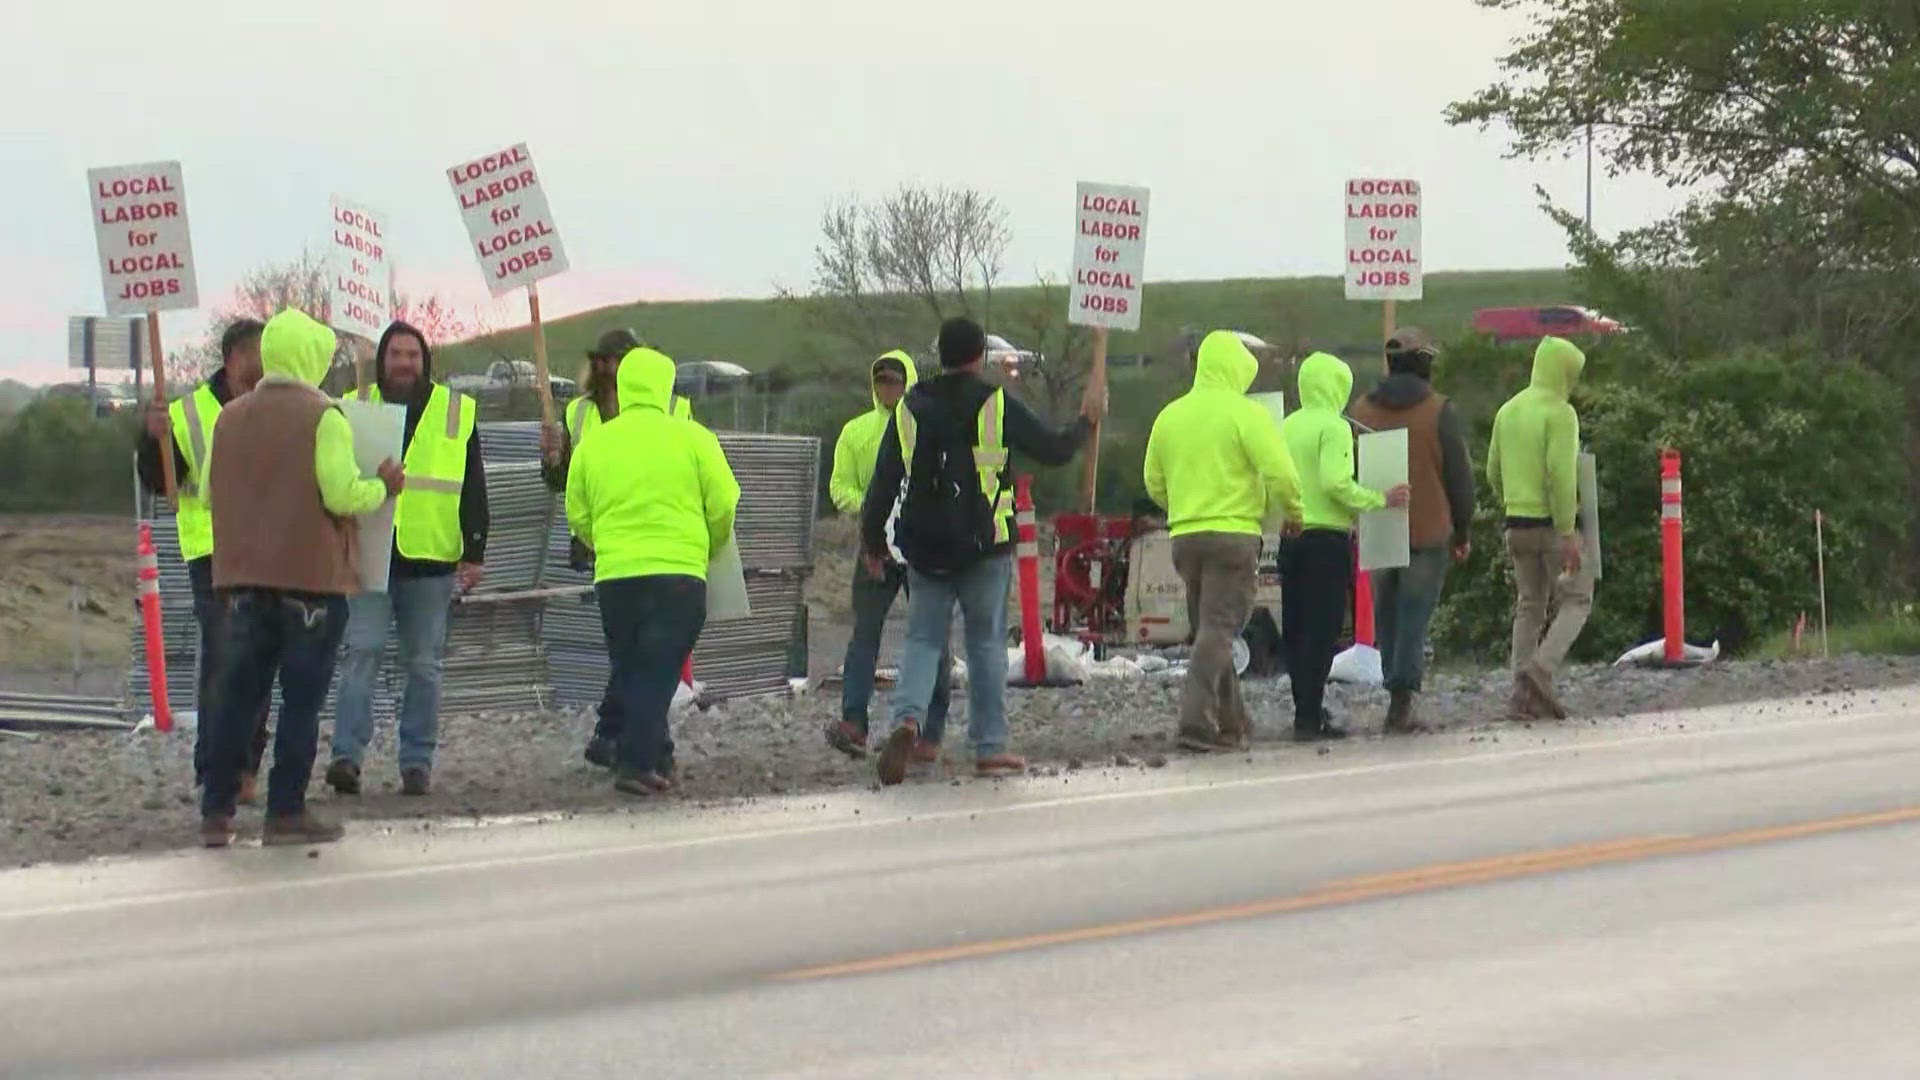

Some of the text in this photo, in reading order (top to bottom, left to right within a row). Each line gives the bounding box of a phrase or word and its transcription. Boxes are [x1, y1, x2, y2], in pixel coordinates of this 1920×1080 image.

[453, 147, 527, 185] LOCAL
[99, 176, 175, 198] LOCAL
[460, 169, 536, 210] LABOR
[1349, 180, 1418, 196] LOCAL
[101, 201, 178, 224] LABOR
[491, 204, 520, 226] for
[1083, 195, 1141, 216] LOCAL
[1347, 203, 1418, 218] LABOR
[335, 206, 382, 238] LOCAL
[1081, 219, 1140, 240] LABOR
[128, 230, 158, 247] for
[479, 219, 552, 258] LOCAL
[1369, 225, 1397, 241] for
[335, 229, 383, 261] LABOR
[1095, 244, 1119, 262] for
[109, 252, 185, 275] LOCAL
[495, 245, 553, 279] JOBS
[1349, 248, 1418, 264] LOCAL
[352, 257, 369, 277] for
[119, 278, 180, 299] JOBS
[1077, 268, 1135, 289] LOCAL
[1356, 271, 1410, 286] JOBS
[338, 274, 383, 308] LOCAL
[1080, 293, 1128, 314] JOBS
[344, 301, 380, 329] JOBS
